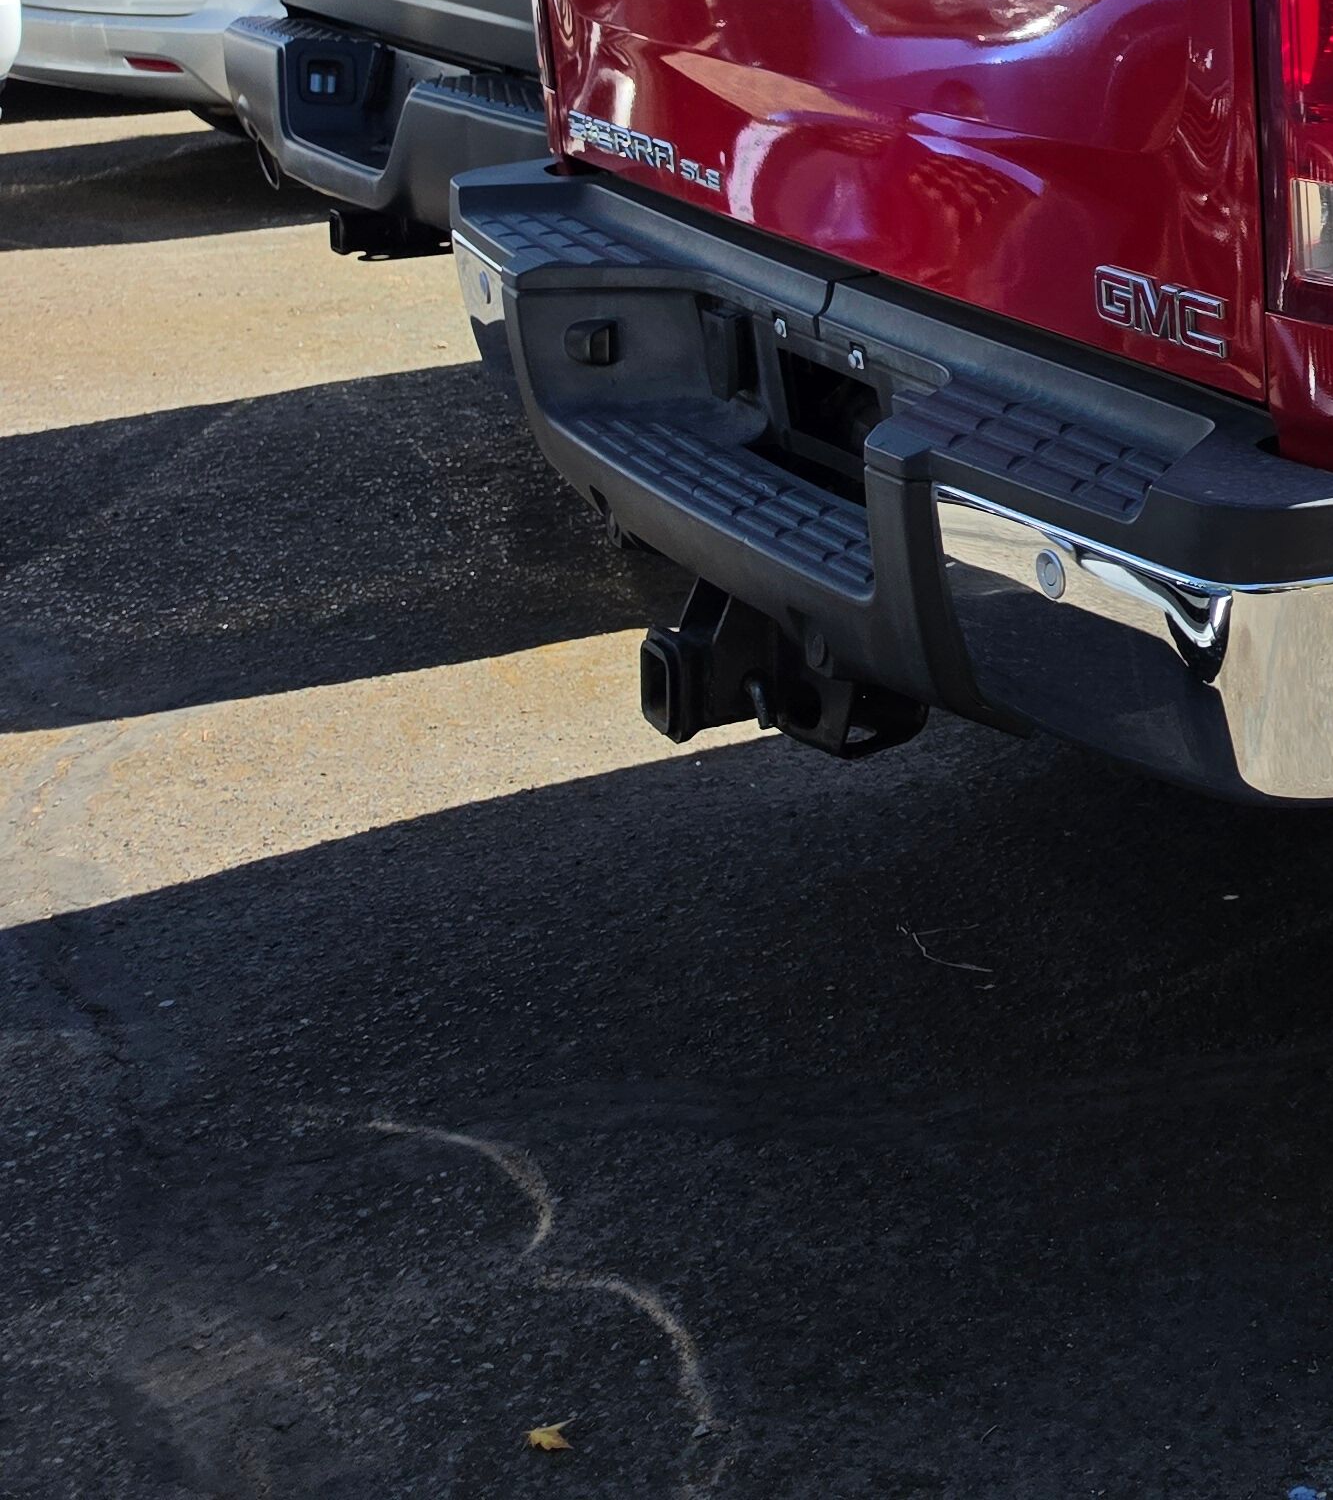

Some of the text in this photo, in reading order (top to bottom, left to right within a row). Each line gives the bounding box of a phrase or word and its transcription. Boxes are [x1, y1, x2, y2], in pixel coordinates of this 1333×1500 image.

[568, 110, 721, 192] SIERRA SLE
[1094, 264, 1227, 359] GMC
